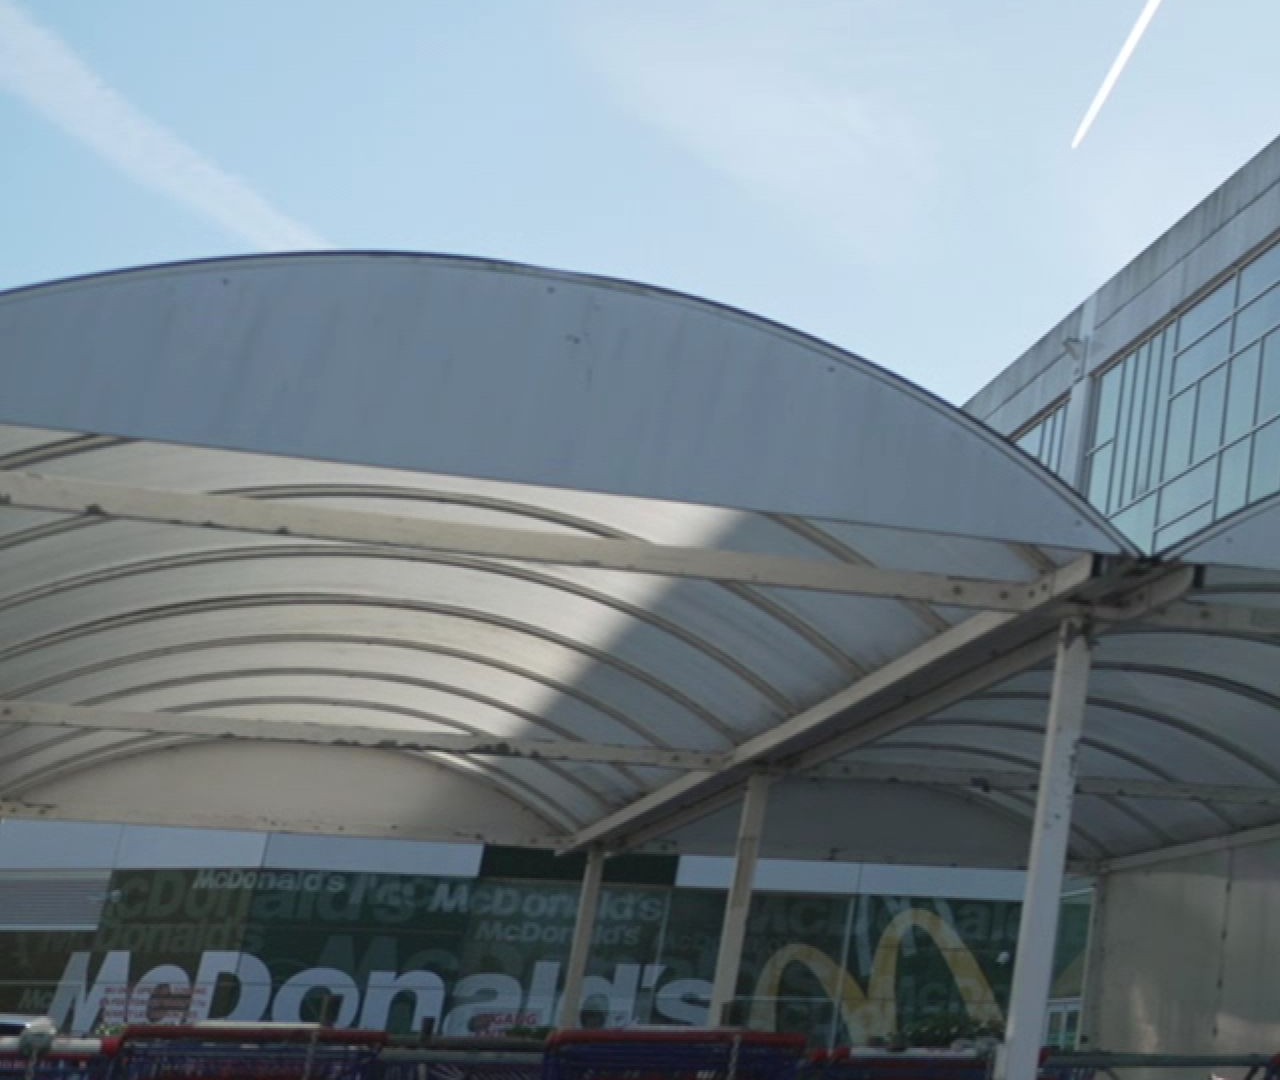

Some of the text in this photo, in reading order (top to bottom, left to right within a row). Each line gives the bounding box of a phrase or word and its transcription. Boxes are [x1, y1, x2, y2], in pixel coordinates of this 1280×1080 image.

[427, 882, 664, 921] McDonld's
[474, 921, 640, 946] McDonld's
[48, 949, 716, 1038] McDonald's
